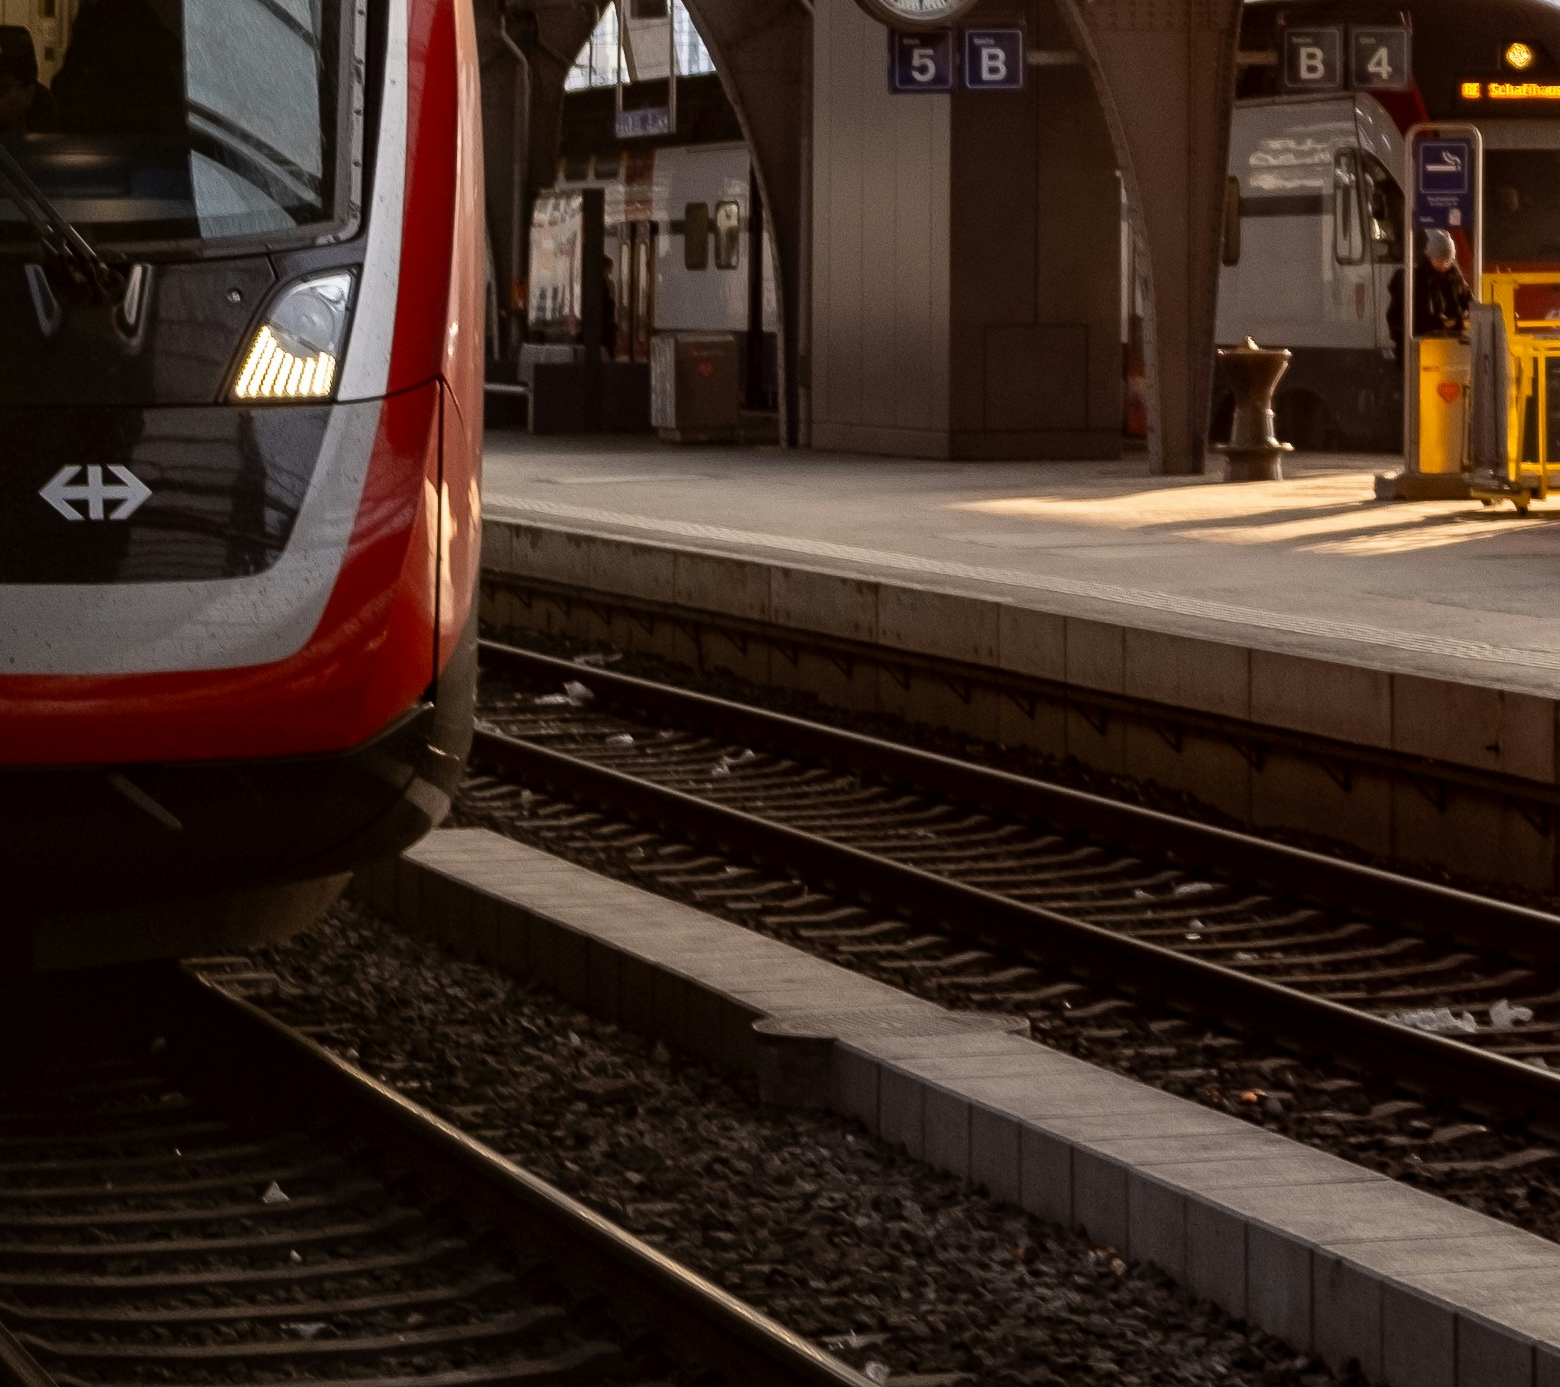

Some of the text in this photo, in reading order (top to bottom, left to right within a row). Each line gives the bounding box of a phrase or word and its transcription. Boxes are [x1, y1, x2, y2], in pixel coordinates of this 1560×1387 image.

[911, 47, 1007, 82] 5 B
[1299, 46, 1393, 80] B 4
